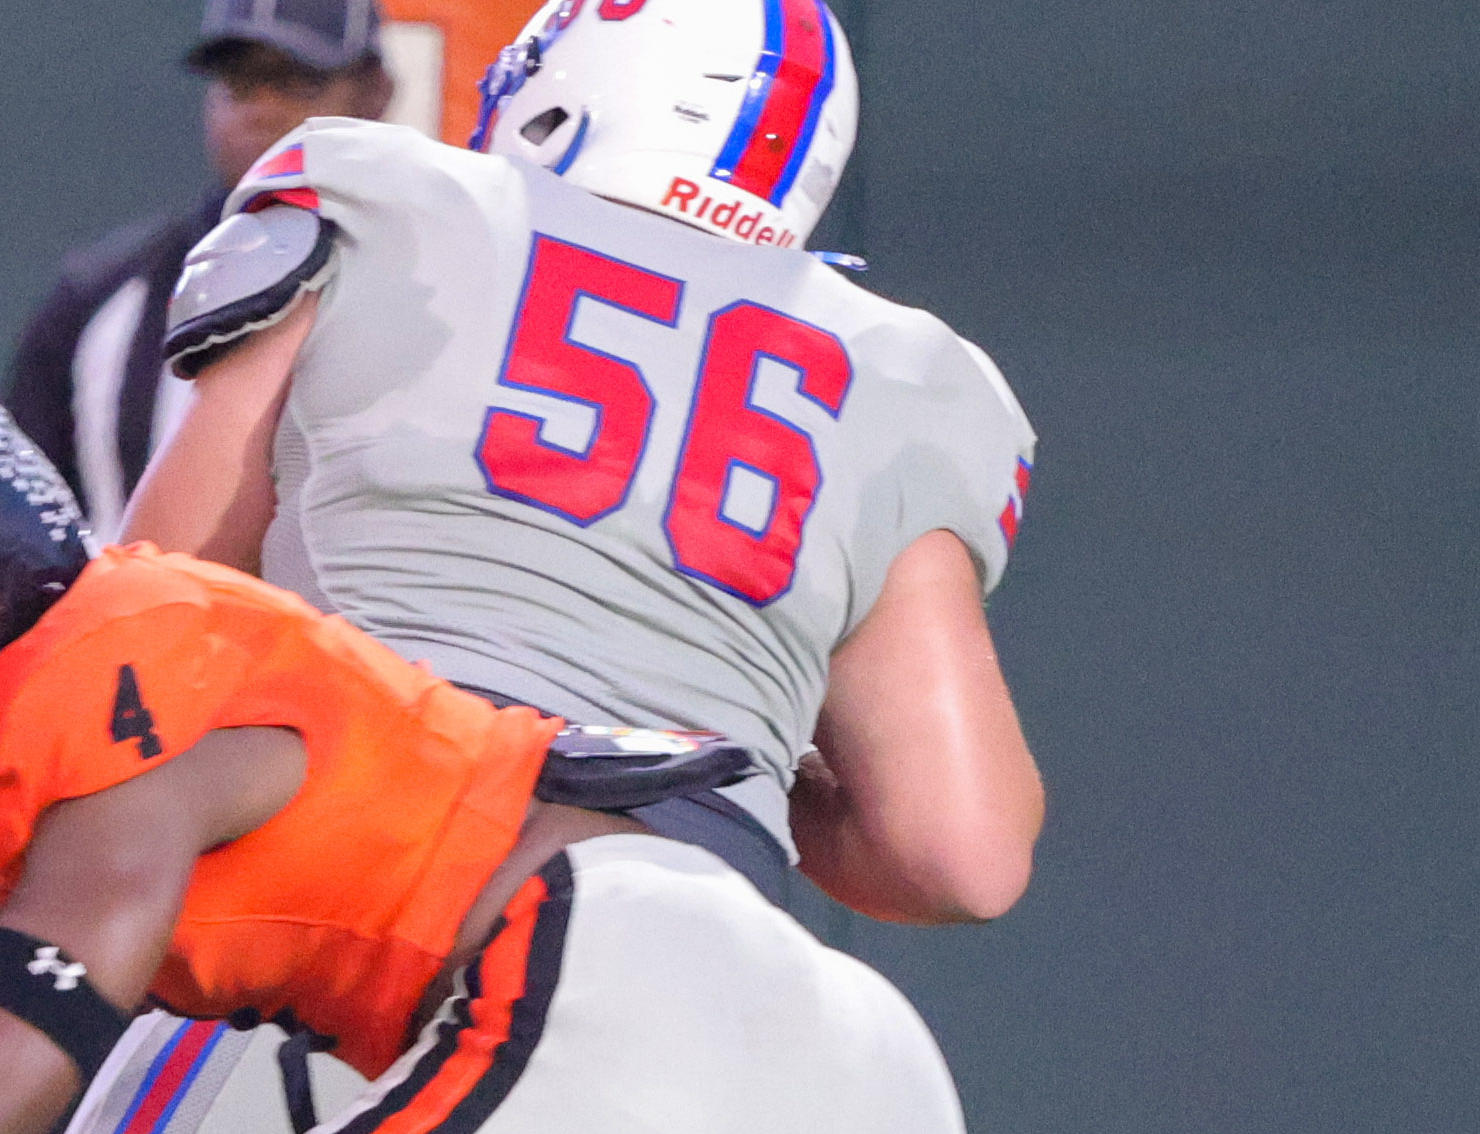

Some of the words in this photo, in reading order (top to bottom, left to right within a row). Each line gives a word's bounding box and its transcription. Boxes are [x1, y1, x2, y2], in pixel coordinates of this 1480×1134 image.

[660, 176, 798, 248] Riddell
[474, 231, 853, 607] 56
[112, 664, 163, 760] 4
